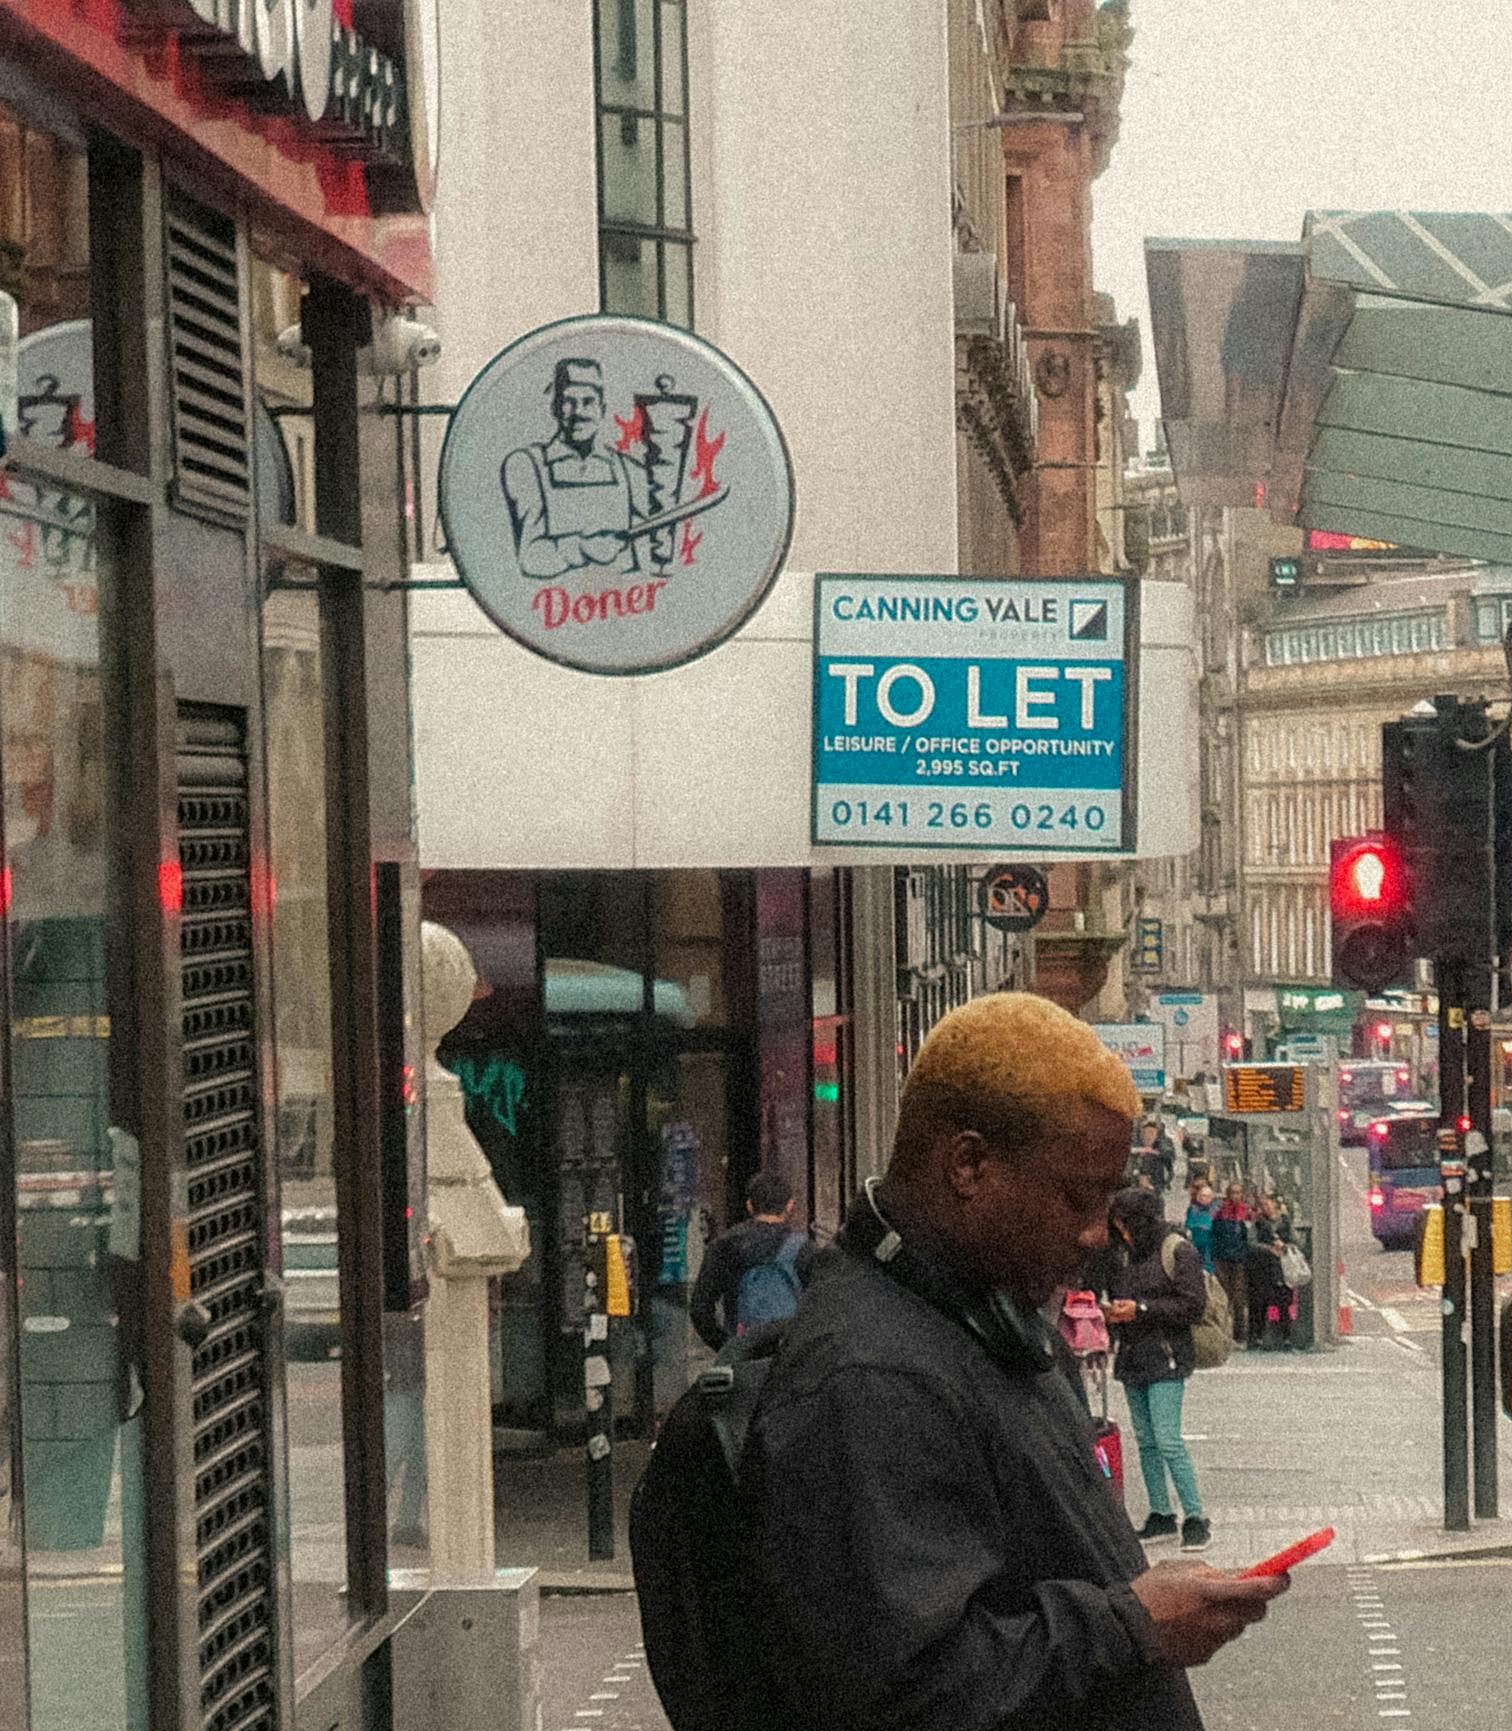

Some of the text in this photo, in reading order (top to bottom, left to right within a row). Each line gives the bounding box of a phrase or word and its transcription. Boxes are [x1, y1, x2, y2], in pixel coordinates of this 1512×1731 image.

[531, 579, 668, 631] Doner
[832, 594, 1059, 623] CANNING VALE
[828, 663, 1112, 730] TO LET
[823, 735, 896, 752] LEISURE
[915, 738, 980, 755] OFFICE
[985, 739, 1115, 757] OPPORTUNITY
[916, 760, 1020, 777] 2,995 SQ.FT
[831, 800, 1105, 831] 0141 266 0240
